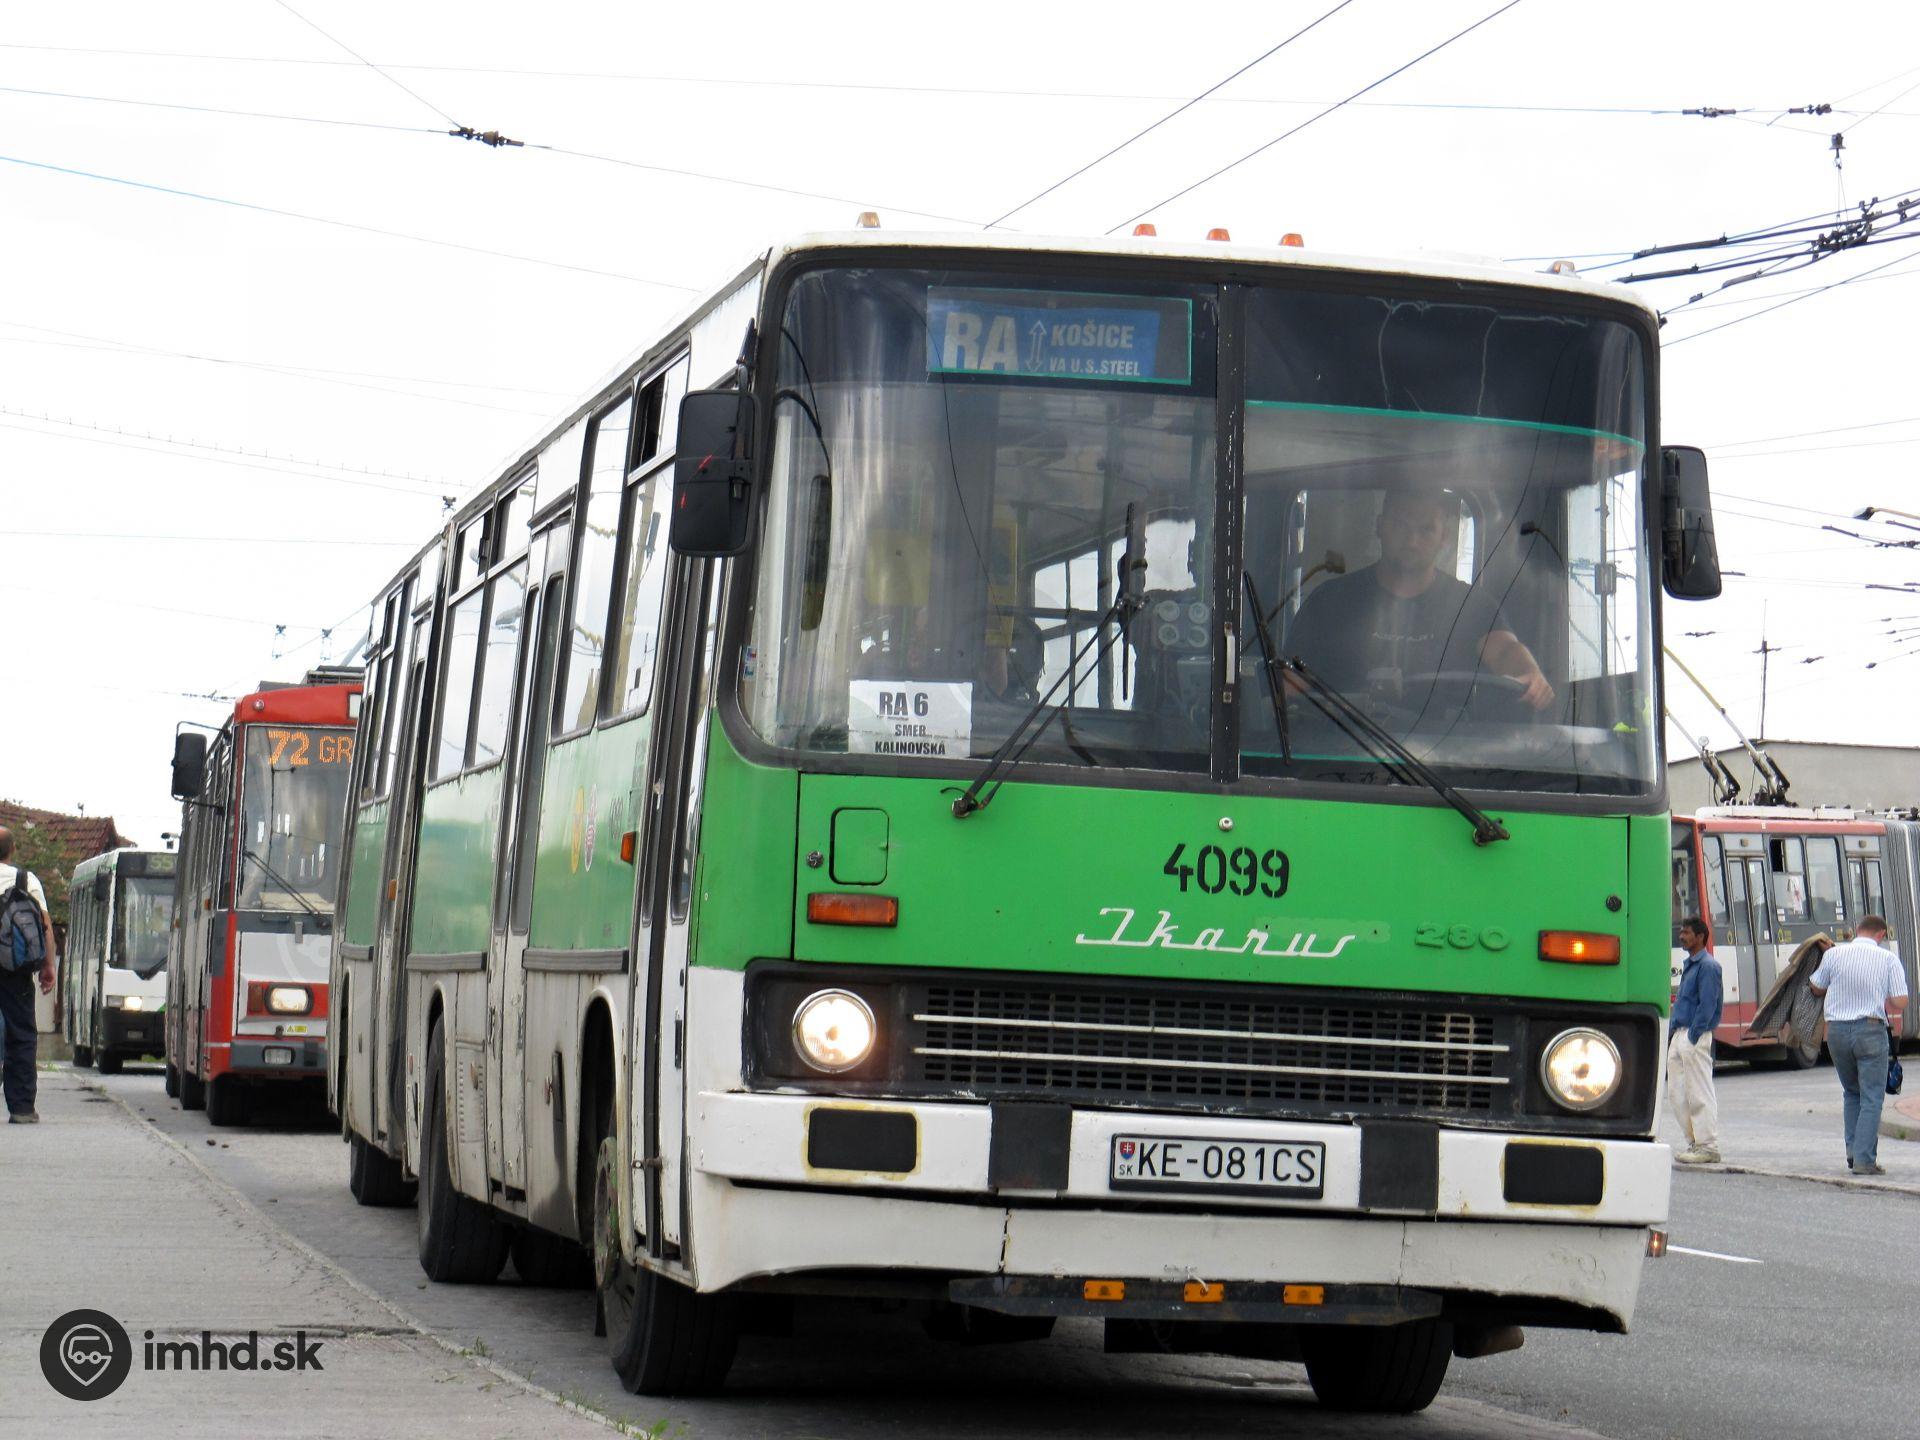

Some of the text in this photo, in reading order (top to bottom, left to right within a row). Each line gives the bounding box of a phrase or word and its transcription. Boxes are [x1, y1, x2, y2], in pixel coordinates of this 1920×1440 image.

[943, 311, 1135, 371] RA KOŠICE
[879, 691, 929, 717] RA 6
[268, 730, 310, 766] 72
[875, 740, 946, 755] KALINOVSKÁ
[1163, 843, 1290, 899] 4099
[1075, 907, 1356, 958] Ikarus
[1414, 921, 1511, 952] 280
[1119, 1163, 1133, 1177] SK
[1138, 1142, 1316, 1183] KE-081CS
